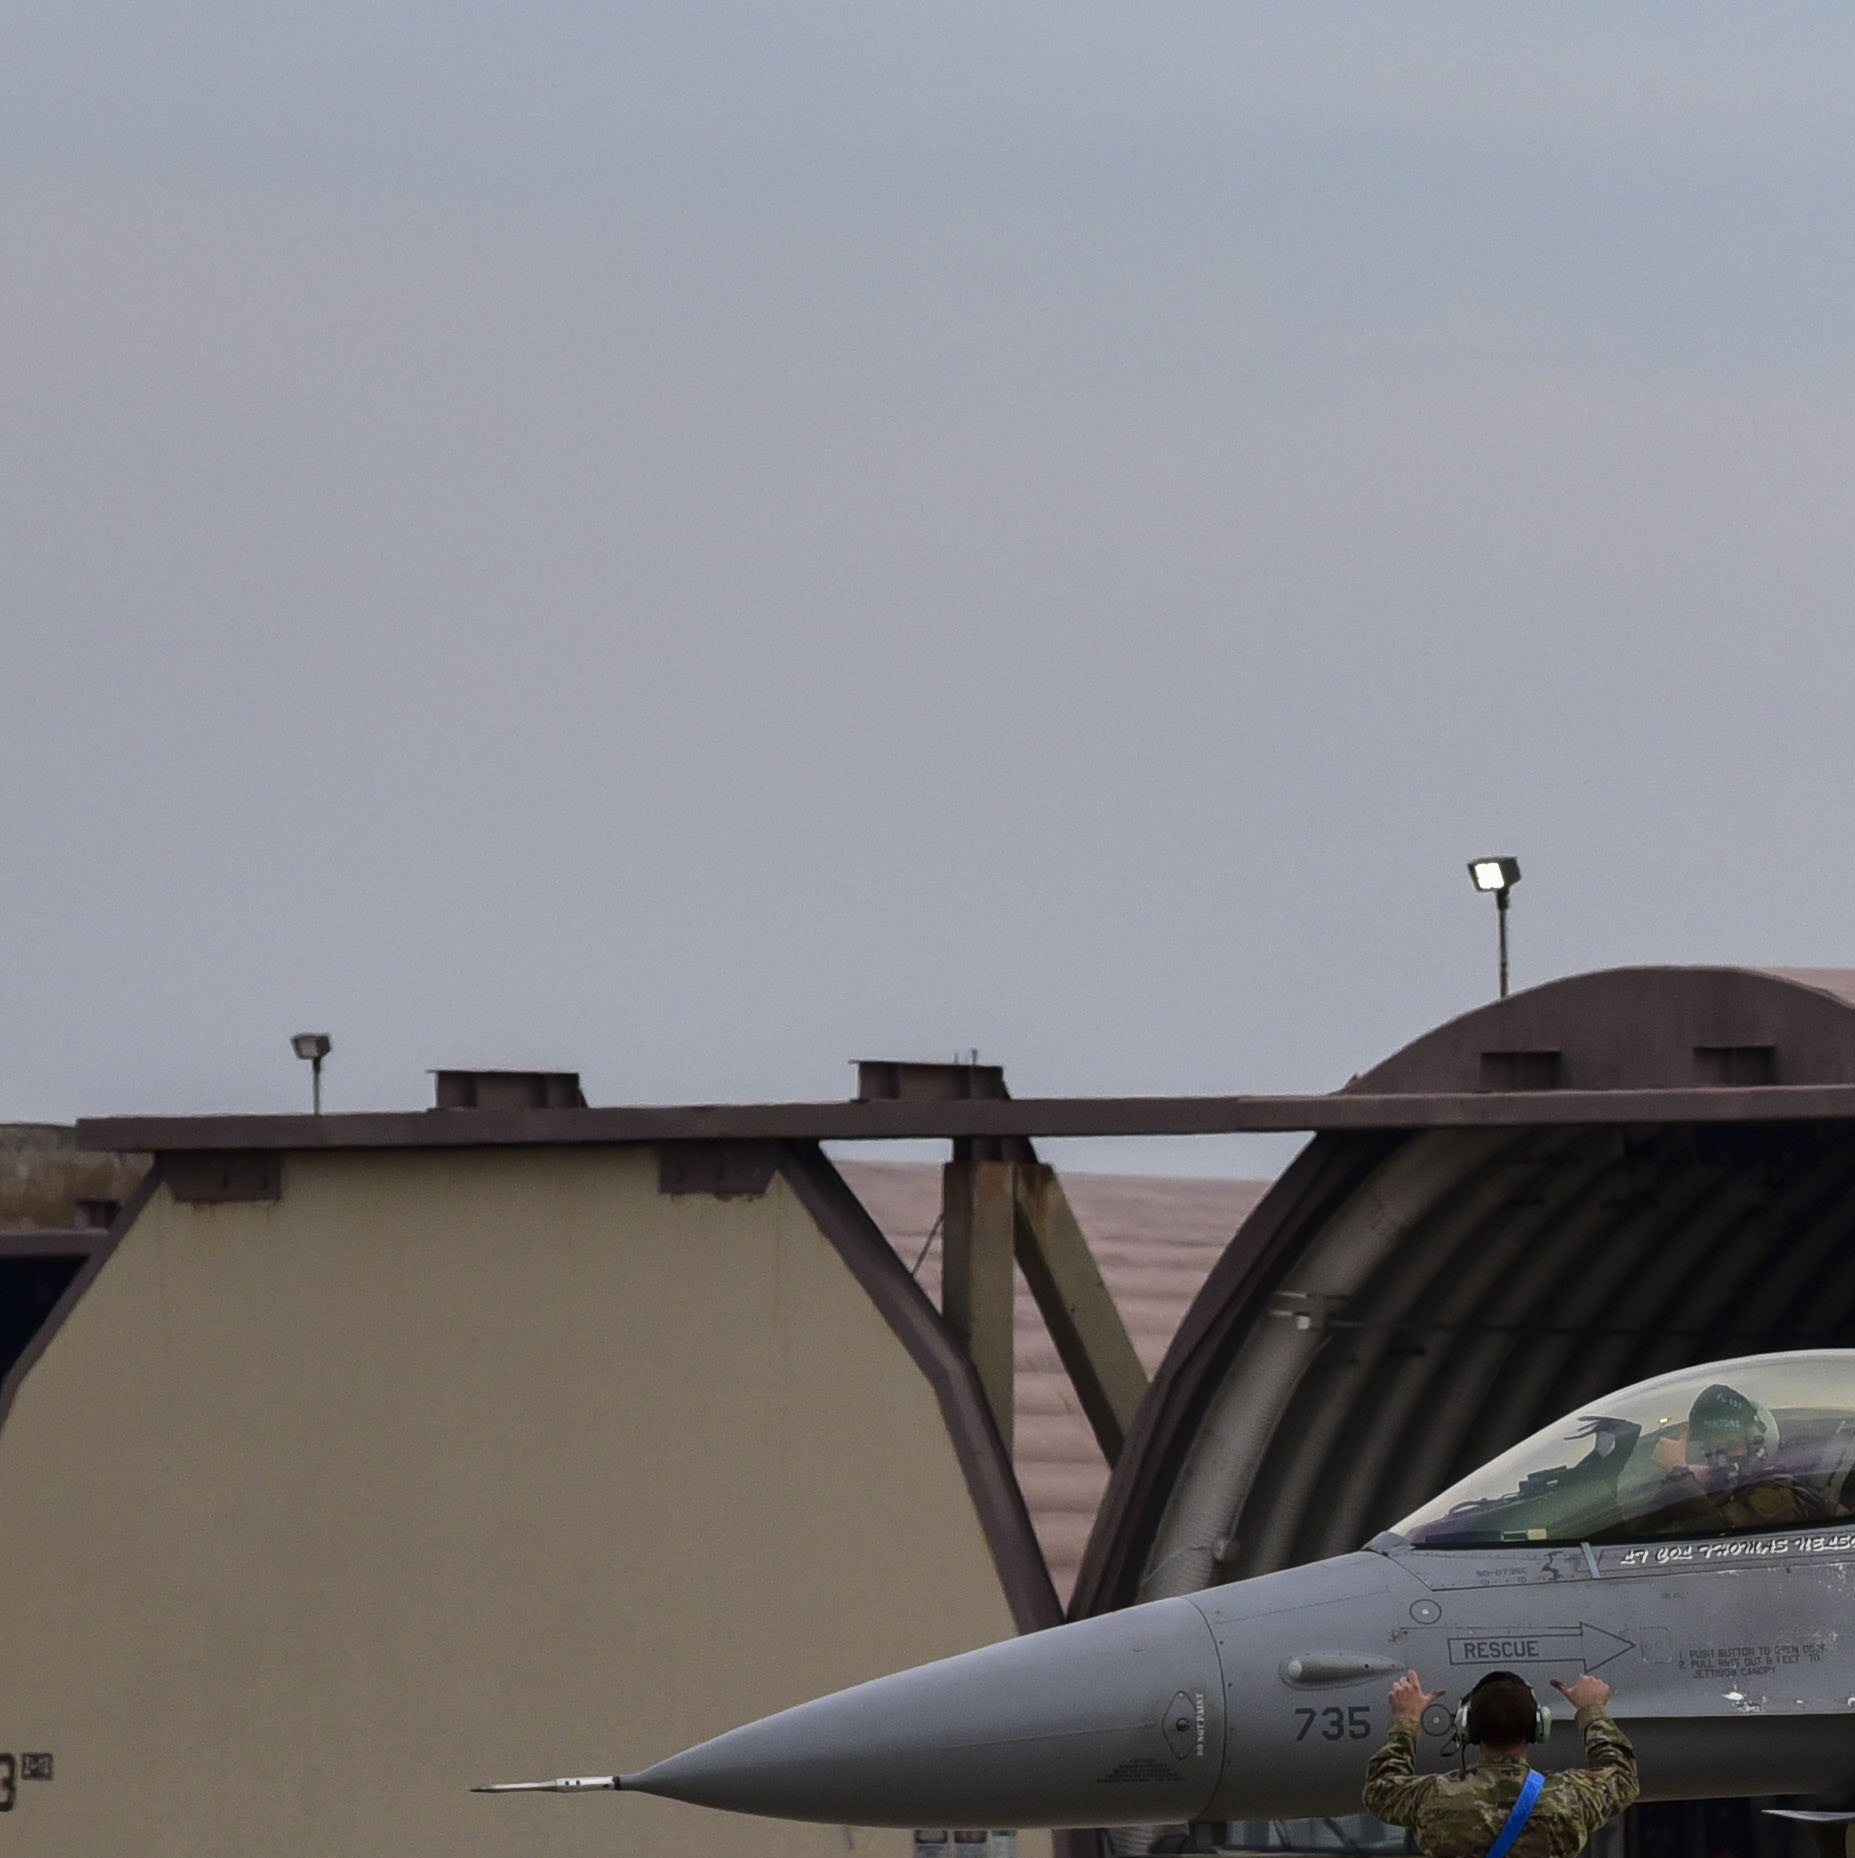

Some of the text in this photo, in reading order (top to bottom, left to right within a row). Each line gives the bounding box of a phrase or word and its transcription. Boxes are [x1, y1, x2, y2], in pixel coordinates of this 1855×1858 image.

[1620, 1549, 1649, 1564] LT
[1656, 1545, 1693, 1564] COL
[1699, 1539, 1789, 1560] THOMAS
[1463, 1640, 1540, 1660] RESCUE
[1689, 1649, 1714, 1659] PUSH
[1718, 1647, 1755, 1658] BUTTON
[1759, 1646, 1770, 1656] TO
[1690, 1659, 1714, 1669] PULL
[1744, 1656, 1761, 1667] OUT
[1693, 1666, 1777, 1679] JETTISON CANOPY
[1195, 1693, 1204, 1722] PAINT
[1295, 1706, 1371, 1741] 735
